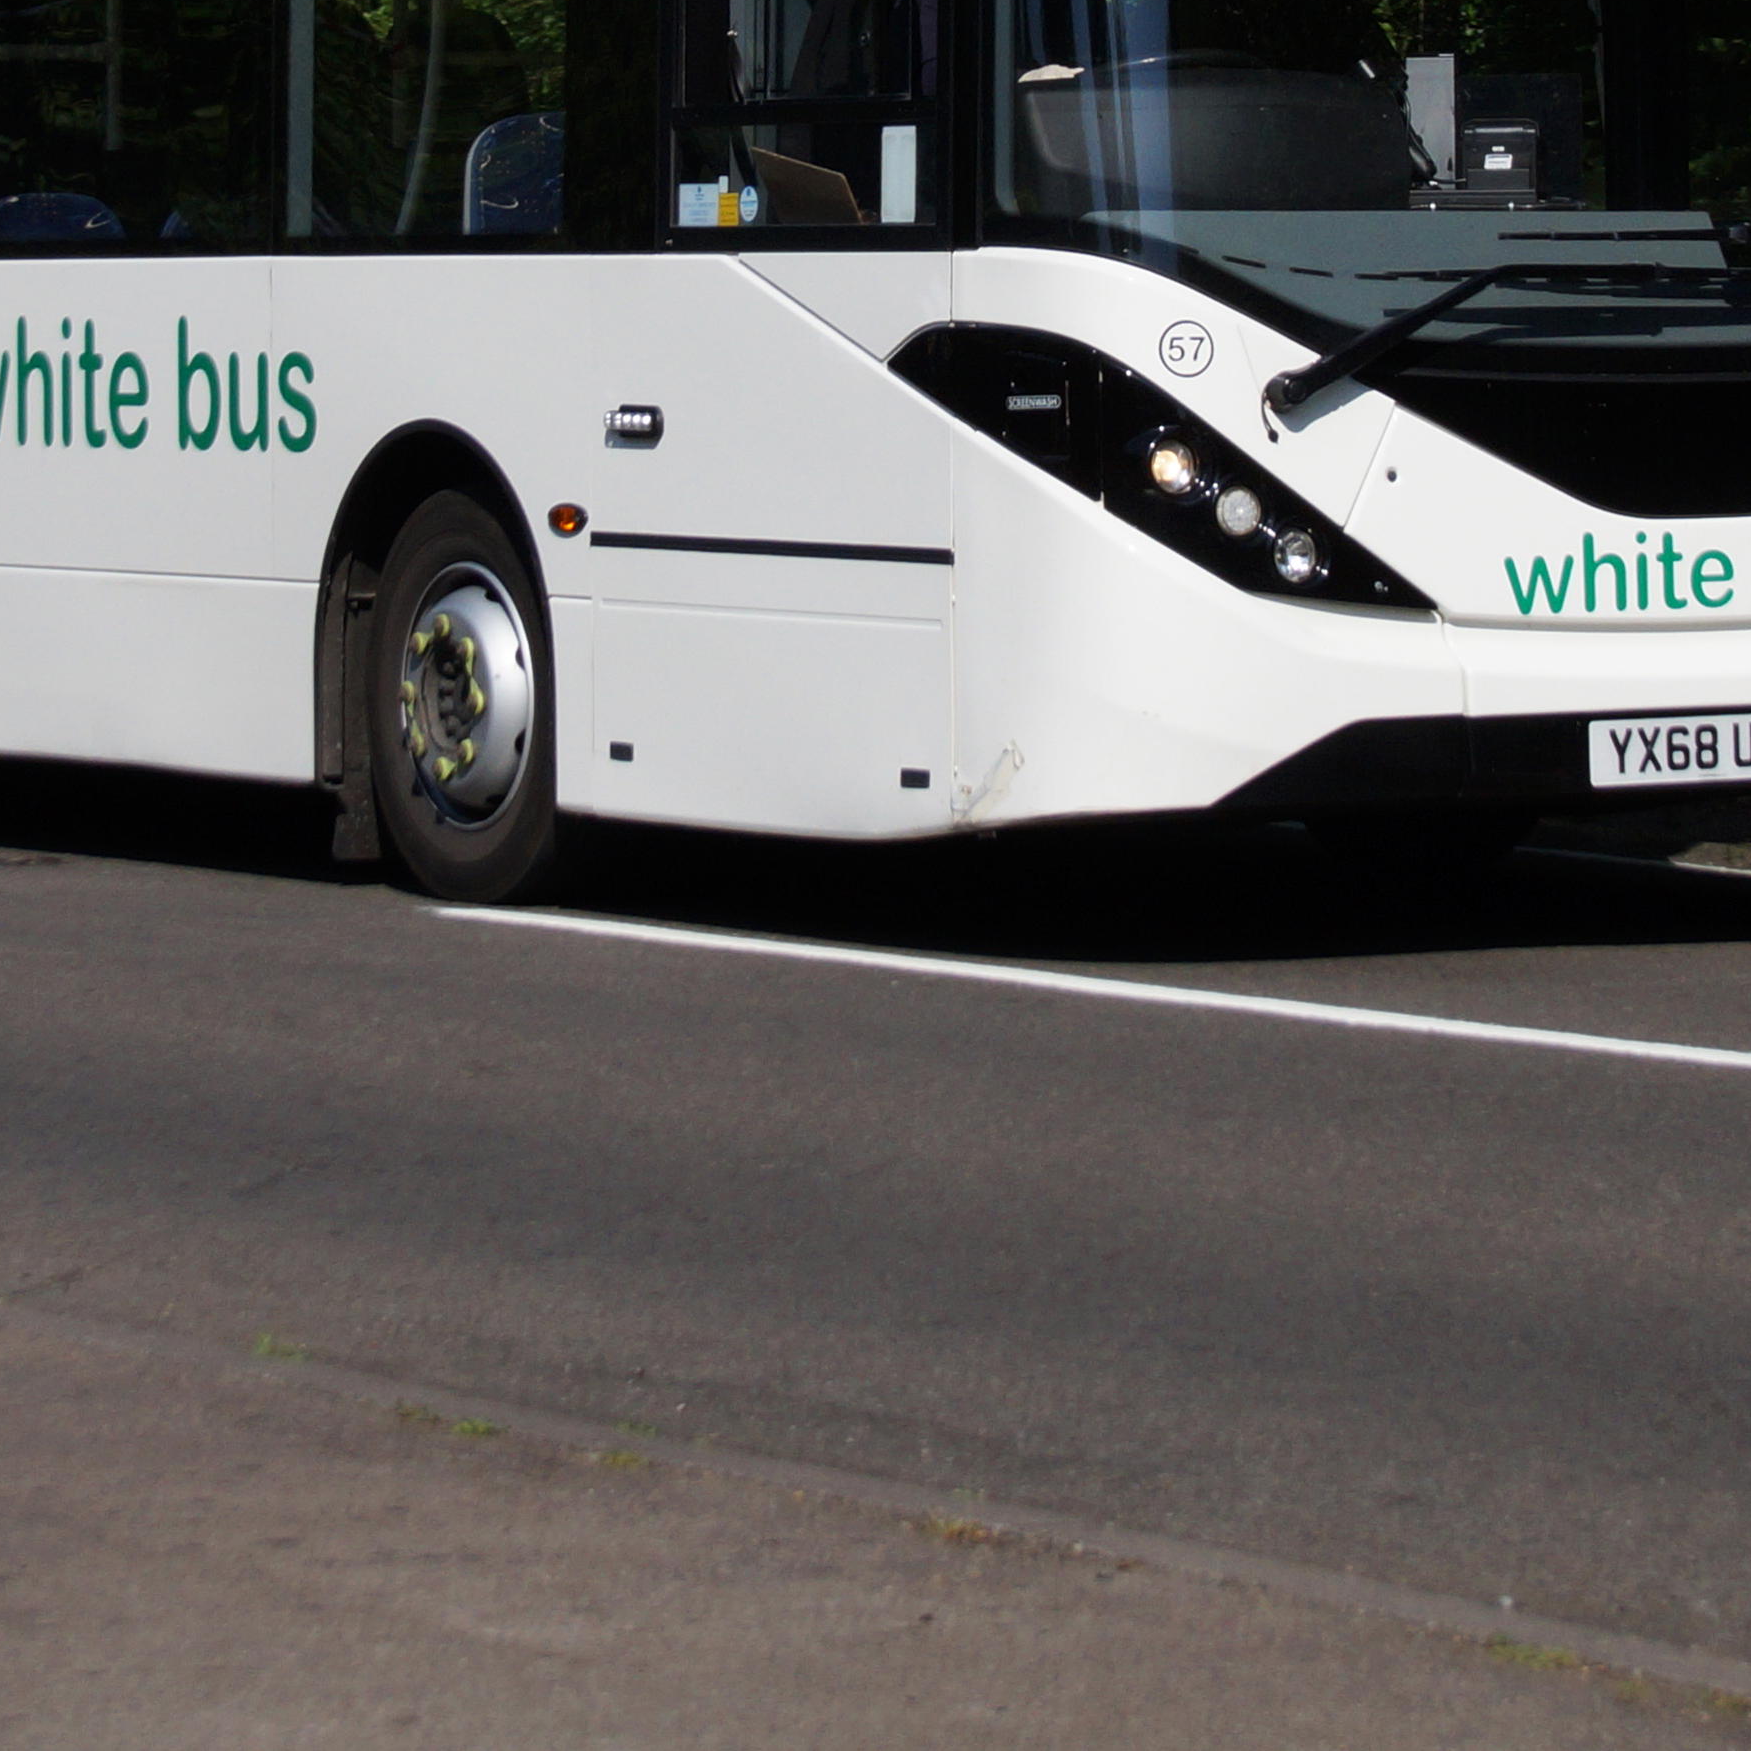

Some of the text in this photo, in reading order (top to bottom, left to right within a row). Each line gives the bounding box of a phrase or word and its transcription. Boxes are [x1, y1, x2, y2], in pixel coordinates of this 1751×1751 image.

[1168, 336, 1205, 362] 57
[176, 315, 317, 453] bus
[1504, 530, 1735, 616] white
[1608, 724, 1720, 774] YX68
